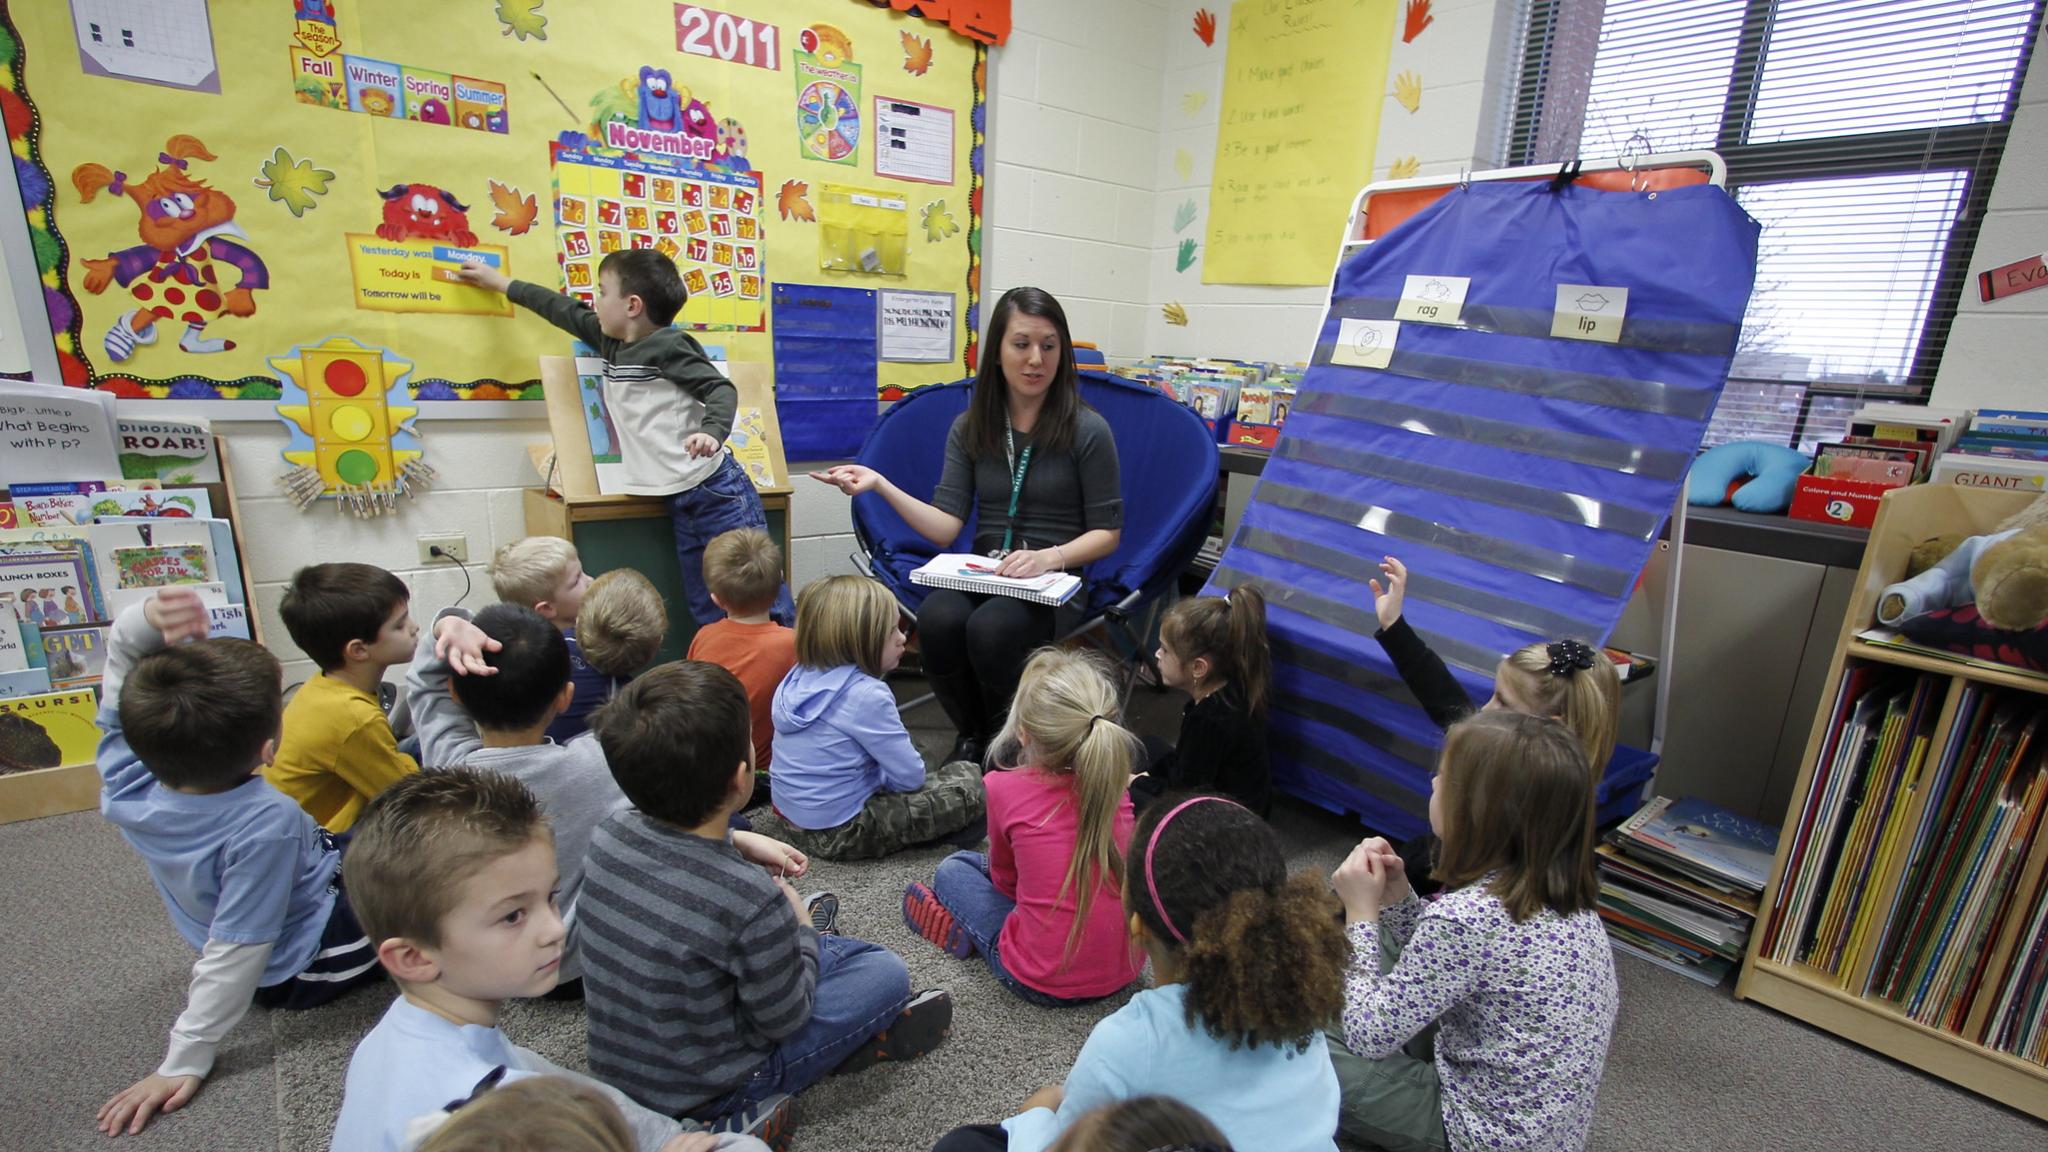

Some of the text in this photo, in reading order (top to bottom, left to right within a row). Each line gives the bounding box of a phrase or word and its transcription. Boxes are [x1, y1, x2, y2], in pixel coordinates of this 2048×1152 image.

[308, 23, 326, 34] The
[301, 31, 335, 45] season
[680, 7, 776, 69] 2011
[314, 43, 324, 52] is
[302, 58, 333, 77] Fall
[349, 65, 398, 88] Winter
[406, 76, 450, 100] Spring
[456, 84, 504, 105] Summer
[608, 123, 714, 160] November
[562, 151, 583, 161] Sunday
[593, 156, 615, 165] Monday
[637, 182, 645, 197] 1
[665, 187, 674, 201] 2
[692, 191, 701, 206] 3
[718, 194, 728, 207] 4
[742, 200, 751, 213] 5
[575, 208, 584, 222] 6
[610, 209, 619, 223] 7
[638, 215, 647, 229] 8
[667, 218, 676, 232] 9
[691, 217, 706, 231] 10
[717, 220, 730, 235] 11
[742, 224, 755, 239] 12
[360, 245, 410, 258] Yesterday
[413, 249, 432, 258] was
[572, 239, 588, 254] 13
[603, 239, 621, 251] 14
[693, 246, 707, 260] 17
[717, 249, 731, 263] 18
[741, 252, 755, 267] 19
[379, 268, 421, 280] Today is
[572, 270, 590, 285] 20
[688, 276, 705, 292] 24
[714, 277, 731, 293] 25
[742, 281, 757, 296] 26
[361, 288, 441, 301] Tomorrow will be
[1417, 303, 1439, 318] rag
[1578, 316, 1596, 334] lip
[0, 406, 17, 415] Big
[37, 421, 90, 434] Begins
[119, 423, 203, 434] DINOSAUR
[10, 437, 81, 450] with P p?
[123, 435, 206, 450] ROAR!
[1954, 472, 2022, 488] GIANT
[89, 484, 97, 493] 3
[1803, 486, 1830, 495] Colors
[1848, 492, 1881, 501] Number
[28, 511, 60, 523] Number
[0, 571, 69, 581] LUNCH BOXES
[142, 567, 163, 577] FOR
[212, 608, 242, 619] Fish
[210, 622, 227, 630] ark
[0, 642, 16, 650] orld
[0, 693, 92, 712] SAURS!
